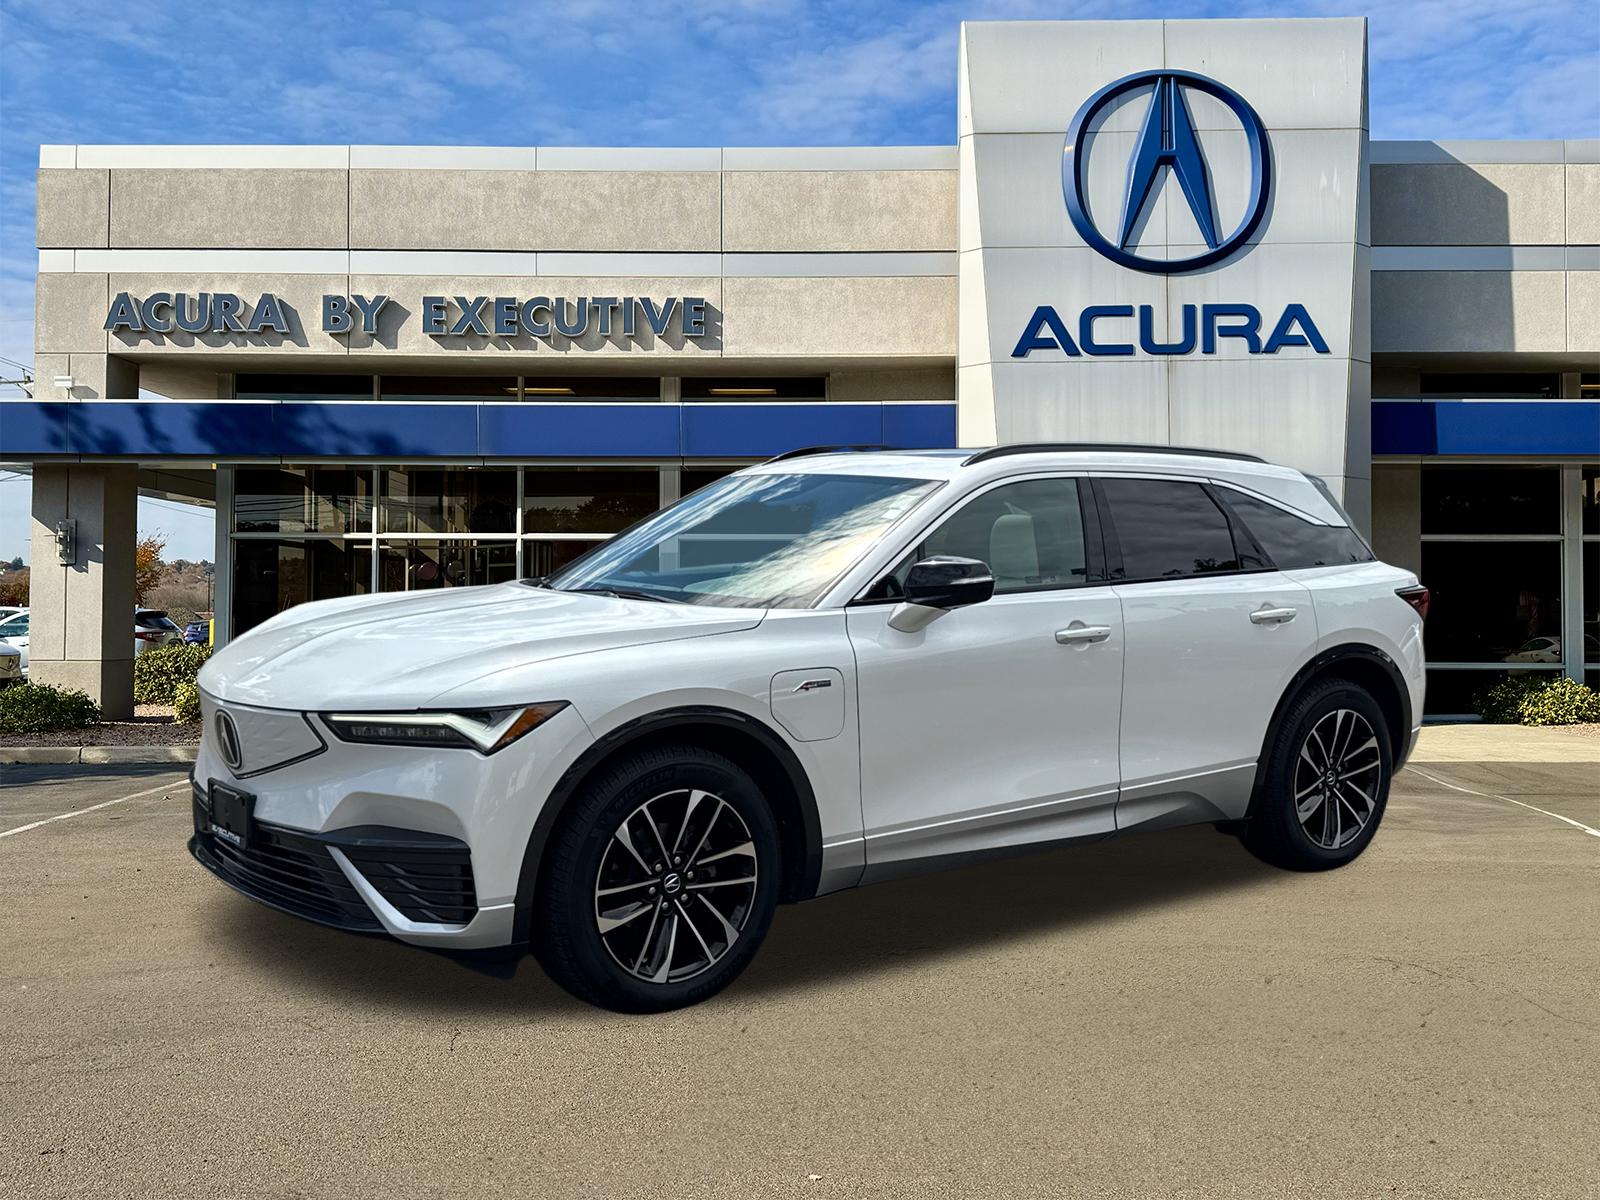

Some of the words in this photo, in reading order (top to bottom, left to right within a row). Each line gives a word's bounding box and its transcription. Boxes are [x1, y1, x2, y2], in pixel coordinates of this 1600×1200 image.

[103, 292, 289, 333] ACURA
[322, 295, 390, 334] BY
[422, 296, 706, 337] EXECUTIVE
[1011, 304, 1332, 357] ACURA
